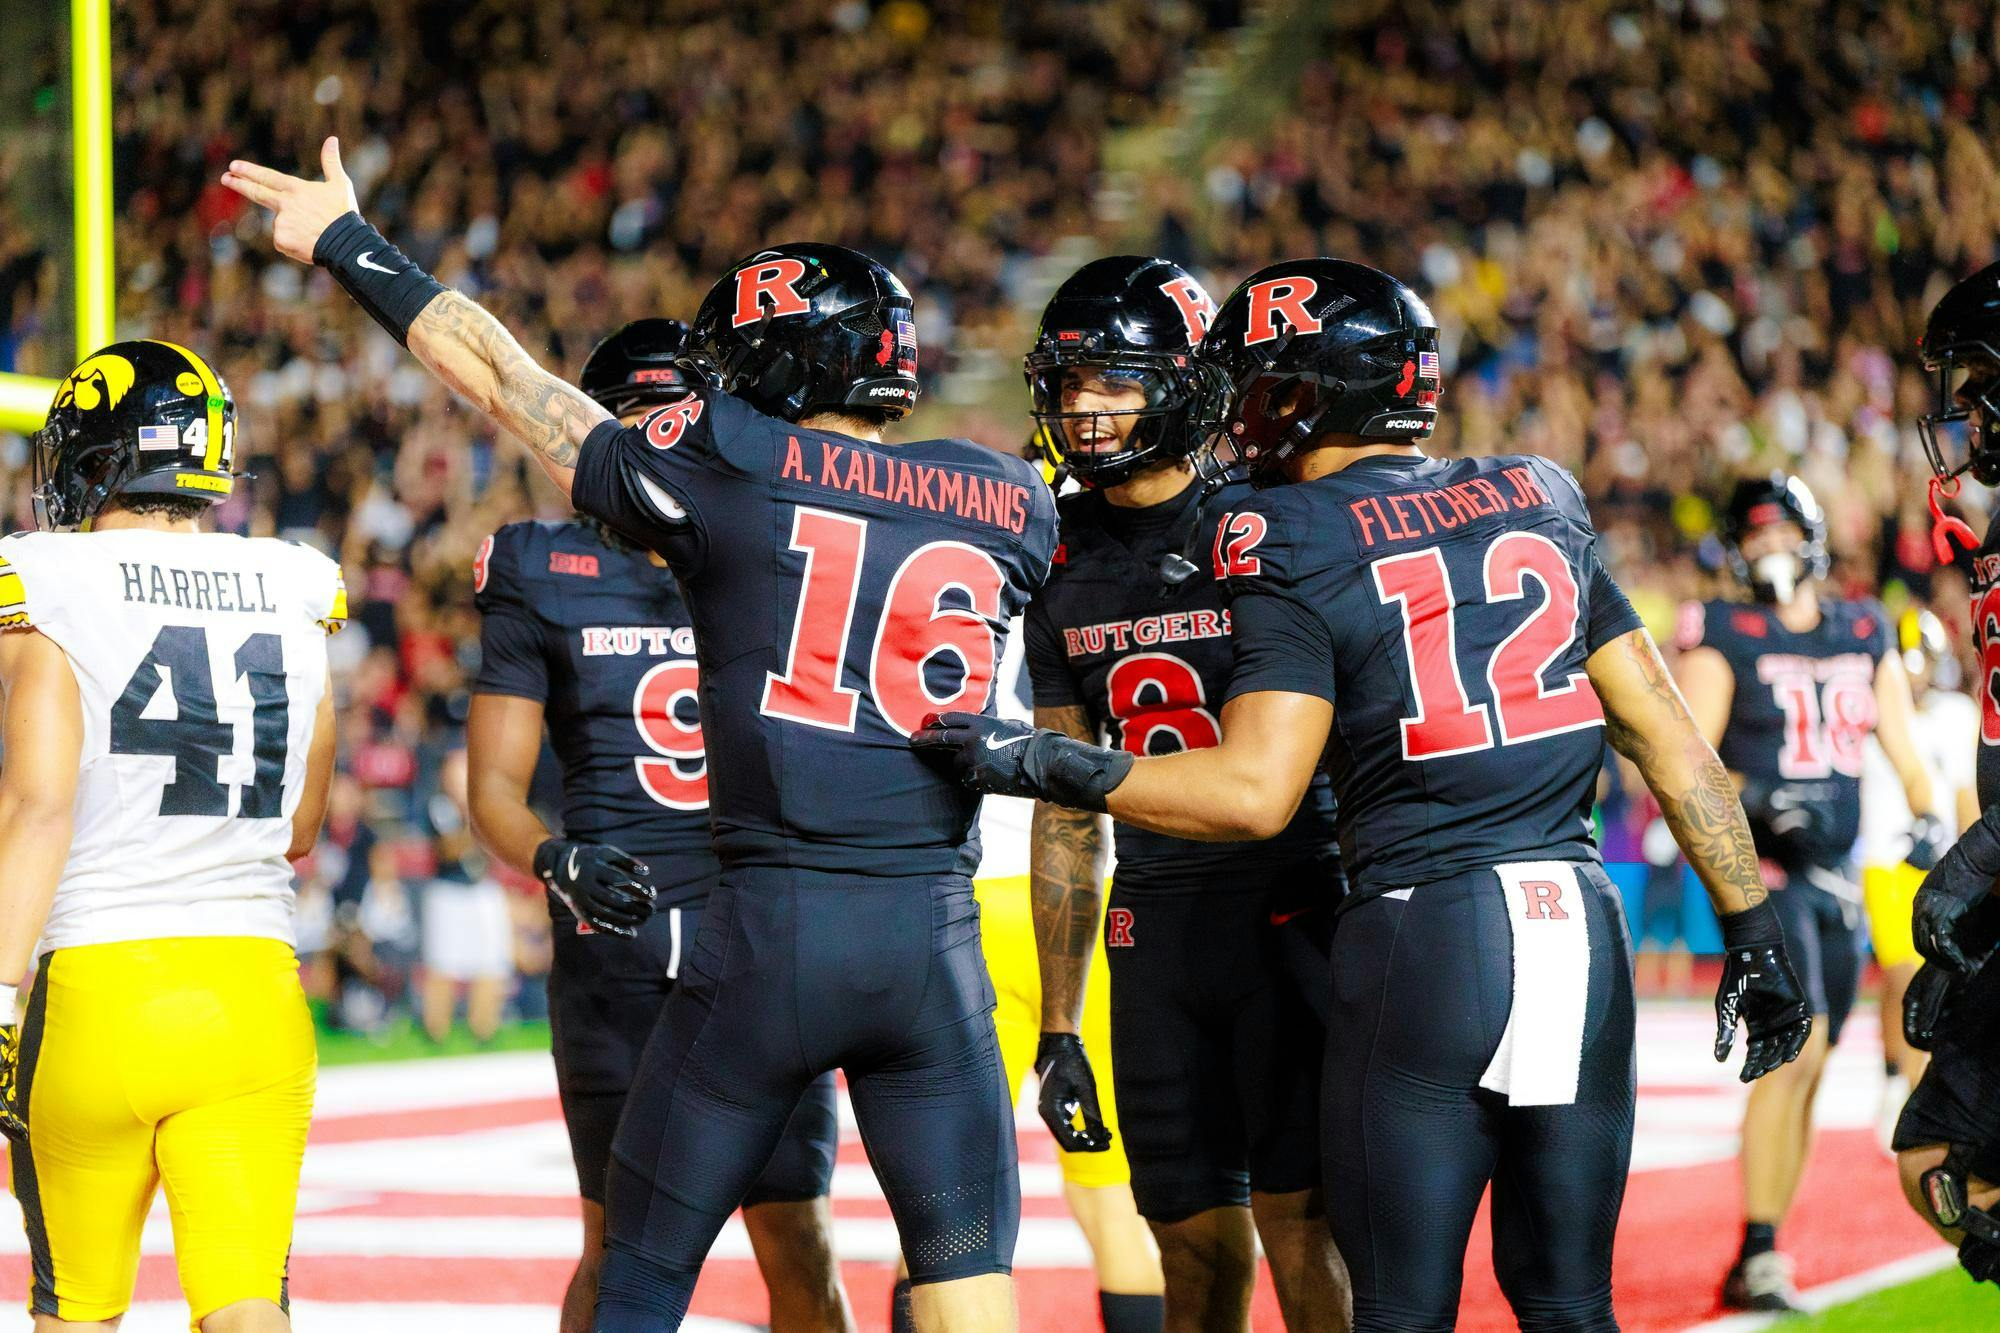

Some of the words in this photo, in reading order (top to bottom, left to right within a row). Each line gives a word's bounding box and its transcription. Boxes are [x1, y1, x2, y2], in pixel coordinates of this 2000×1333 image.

[732, 258, 811, 328] R
[1159, 276, 1217, 346] R
[1244, 276, 1322, 347] R
[183, 418, 234, 461] 41
[781, 437, 812, 483] A.
[821, 442, 1030, 535] KALIAKMANIS
[1350, 477, 1509, 546] FLETCHER
[1504, 466, 1551, 509] JR.
[1212, 512, 1267, 580] 12
[119, 562, 277, 613] HARRELL
[759, 505, 1005, 740] 16
[1370, 530, 1606, 761] 12
[109, 624, 289, 819] 41
[633, 659, 710, 811] 9
[1106, 652, 1223, 758] 8
[1108, 907, 1135, 947] R
[1520, 880, 1569, 920] R
